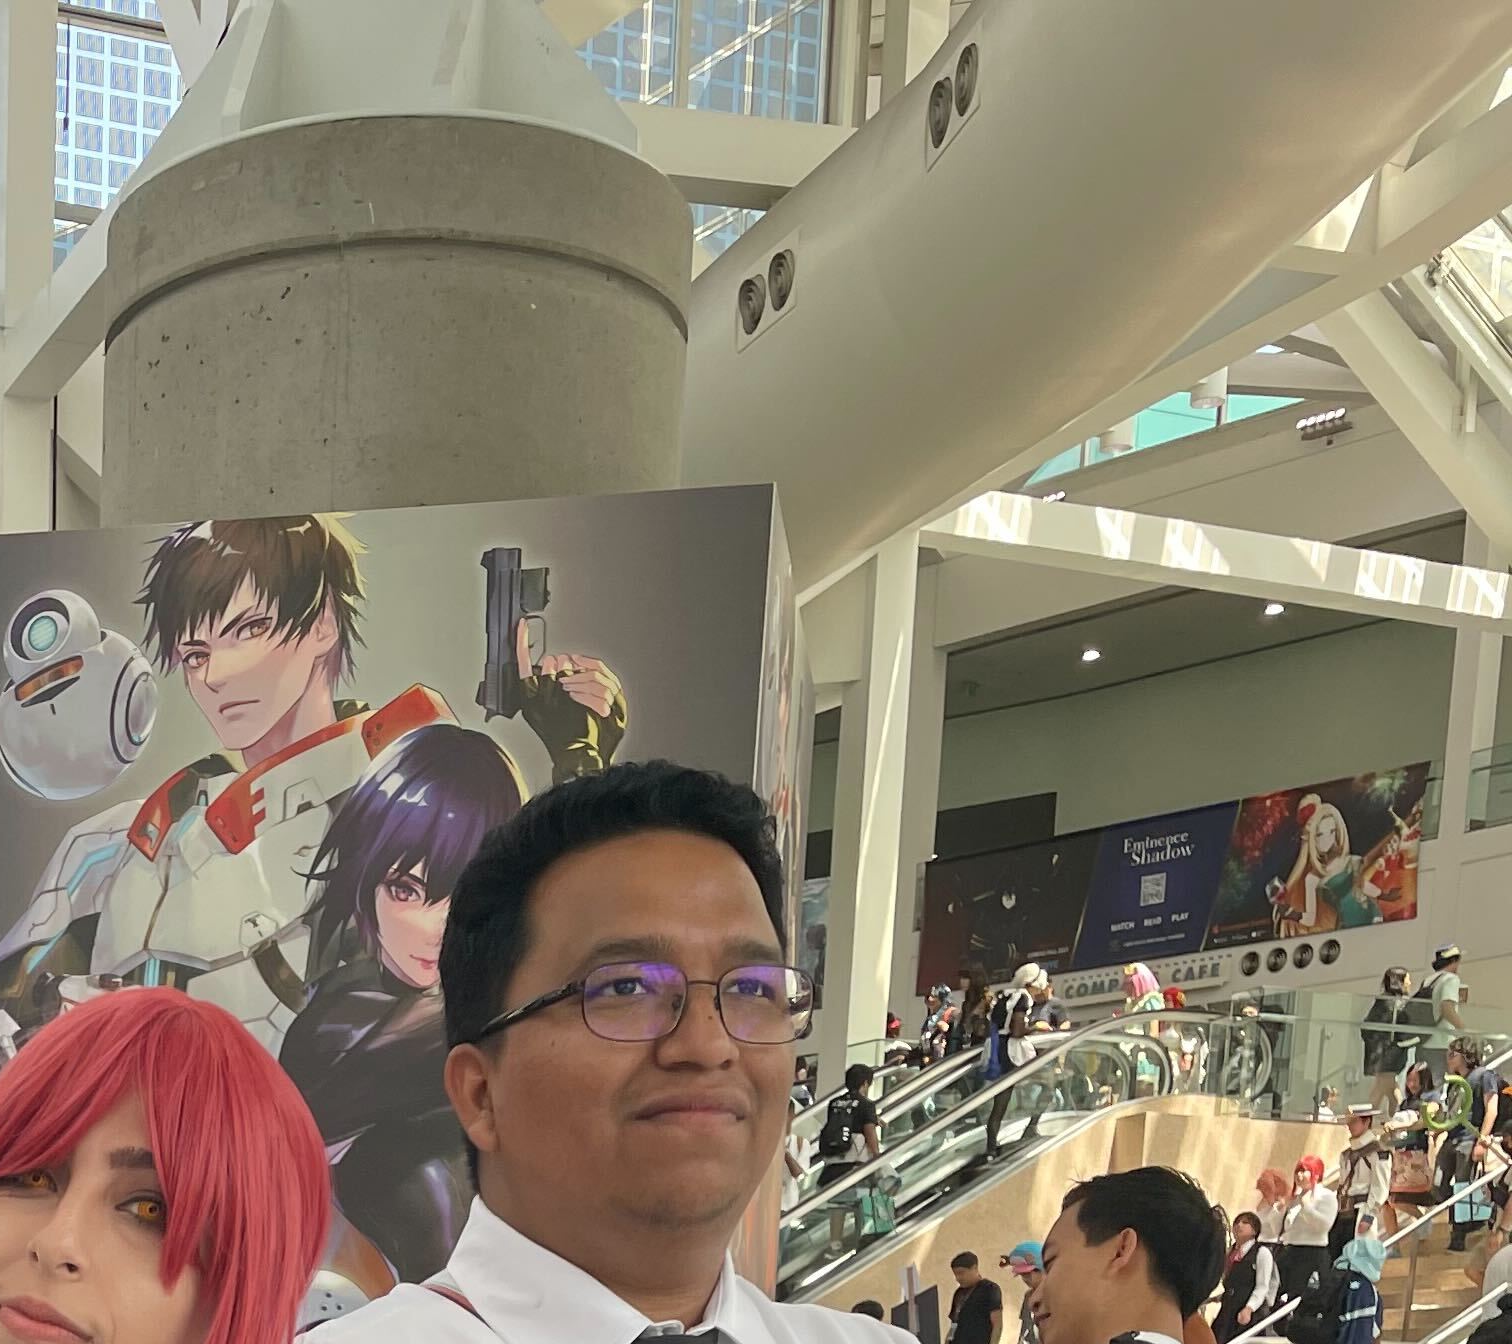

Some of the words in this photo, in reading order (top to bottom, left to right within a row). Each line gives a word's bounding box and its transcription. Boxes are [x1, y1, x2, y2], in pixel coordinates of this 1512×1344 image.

[1123, 832, 1189, 854] Eminence
[1130, 844, 1194, 867] Shadow
[1171, 963, 1221, 983] CAFE
